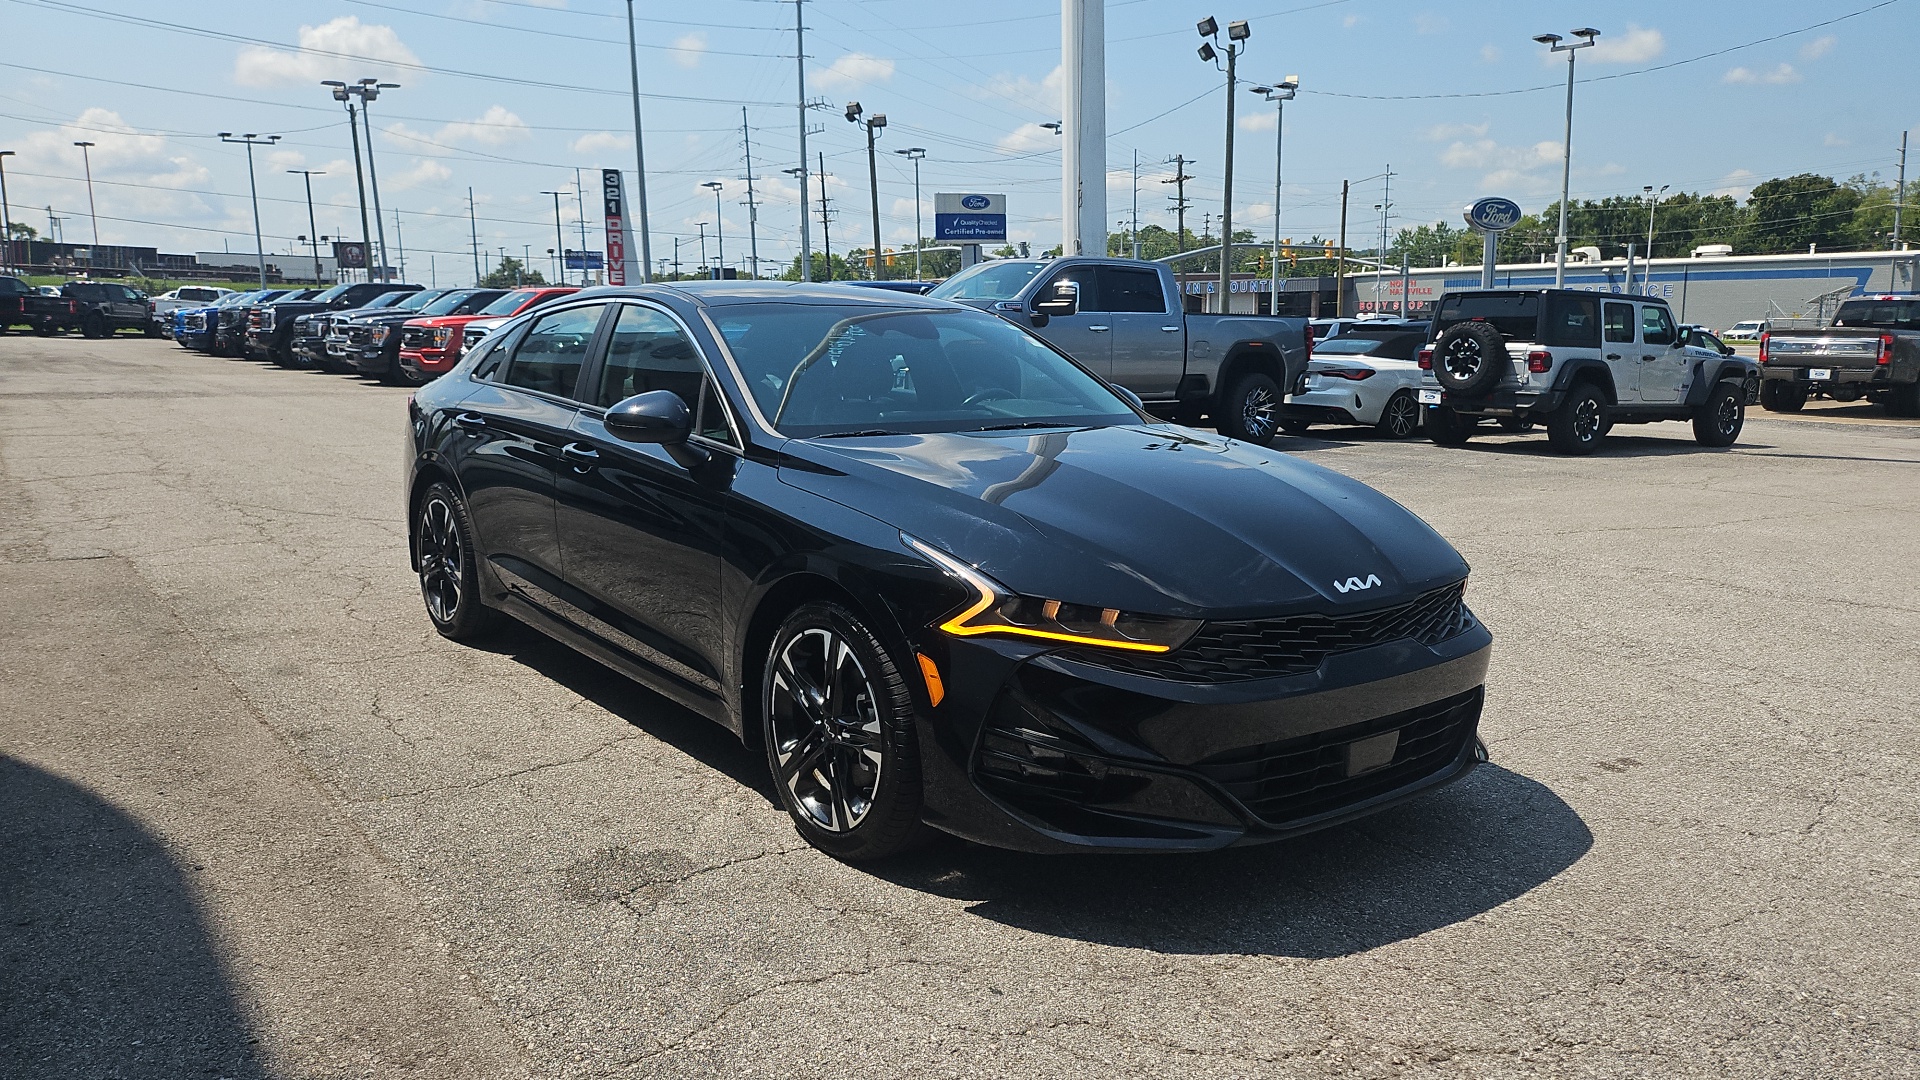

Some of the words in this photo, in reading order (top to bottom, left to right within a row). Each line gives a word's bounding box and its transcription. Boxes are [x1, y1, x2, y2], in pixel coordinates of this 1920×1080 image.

[605, 173, 620, 213] 321
[1482, 203, 1513, 223] Ford
[607, 218, 625, 283] DRIVE
[1229, 279, 1287, 294] OUNTY
[1392, 300, 1424, 311] SOP
[1333, 574, 1382, 593] KIA
